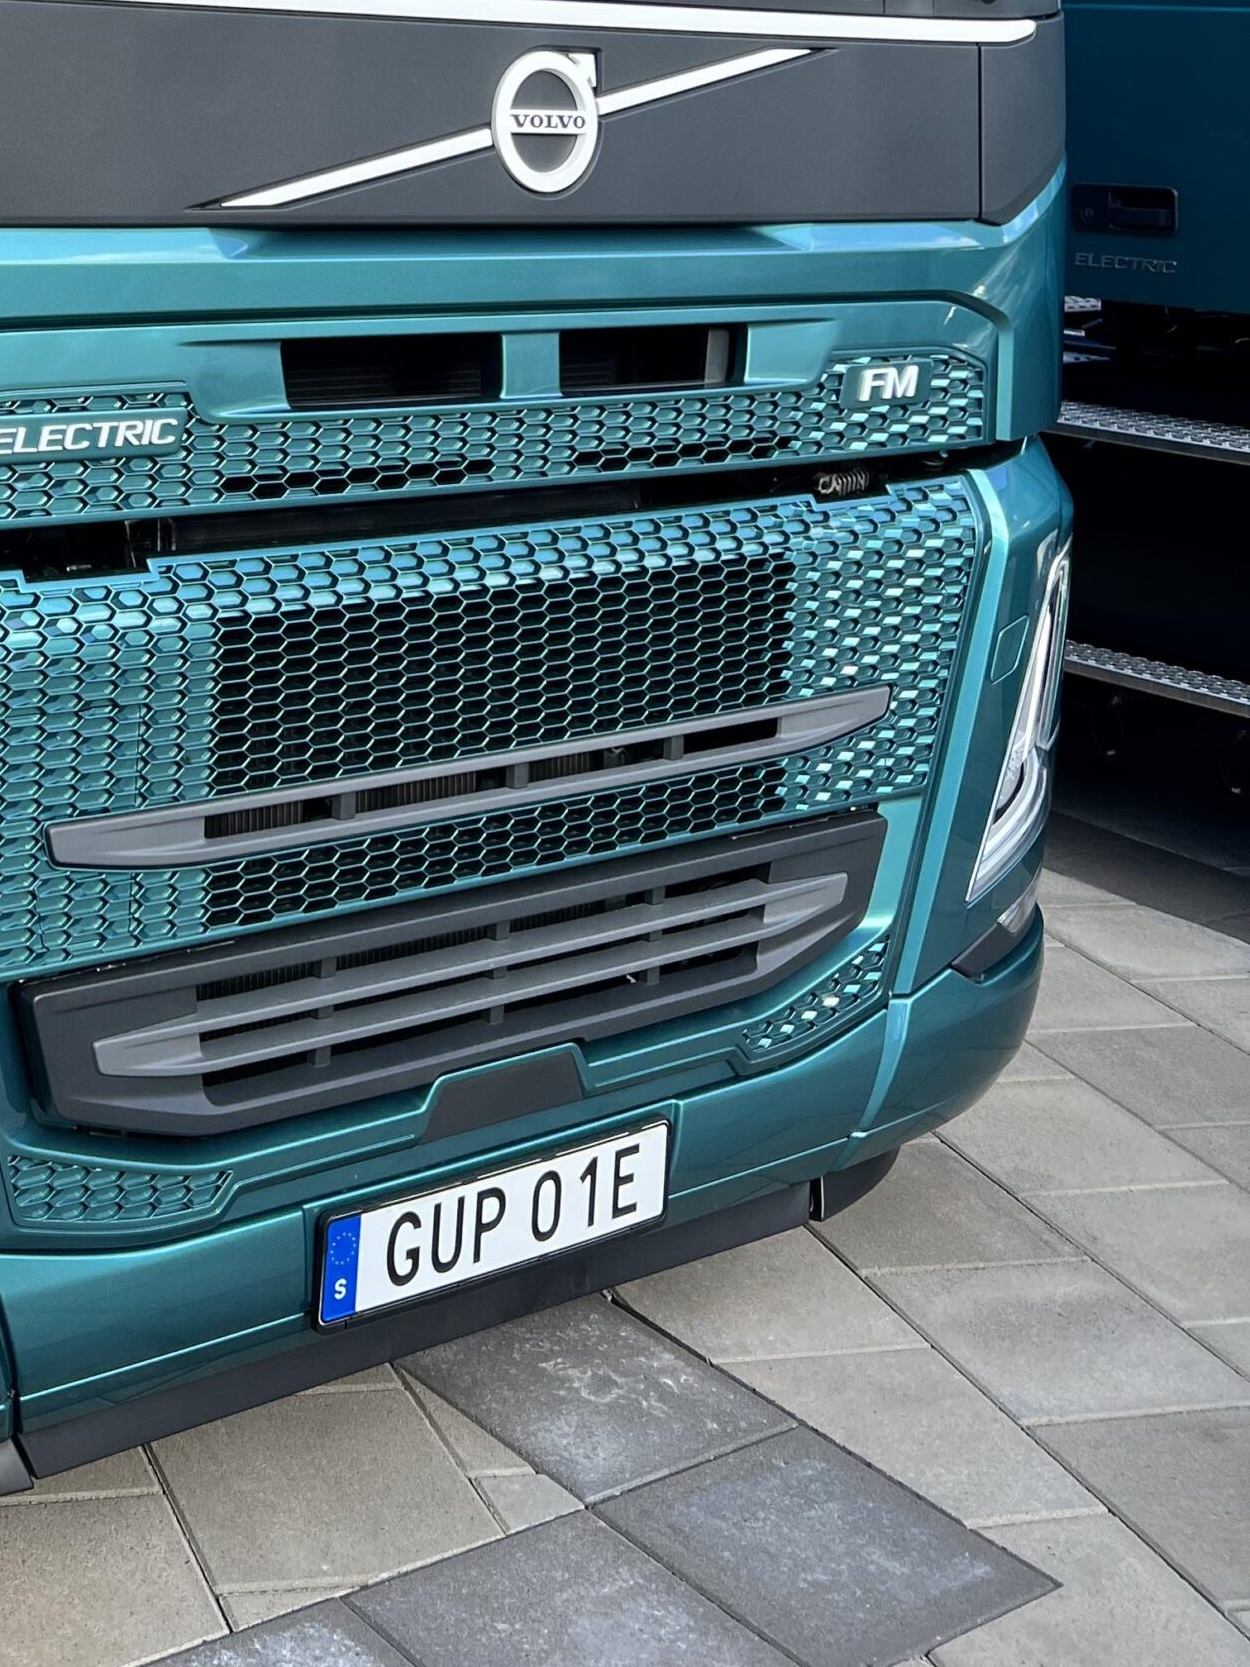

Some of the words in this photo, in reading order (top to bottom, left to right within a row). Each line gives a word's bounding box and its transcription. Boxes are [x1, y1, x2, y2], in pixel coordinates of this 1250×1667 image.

[510, 113, 586, 130] VOLVO
[1074, 251, 1178, 274] ELECTRIC
[858, 364, 920, 403] FM
[333, 1277, 347, 1301] S
[385, 1186, 507, 1287] GUP
[531, 1143, 641, 1243] 01E
